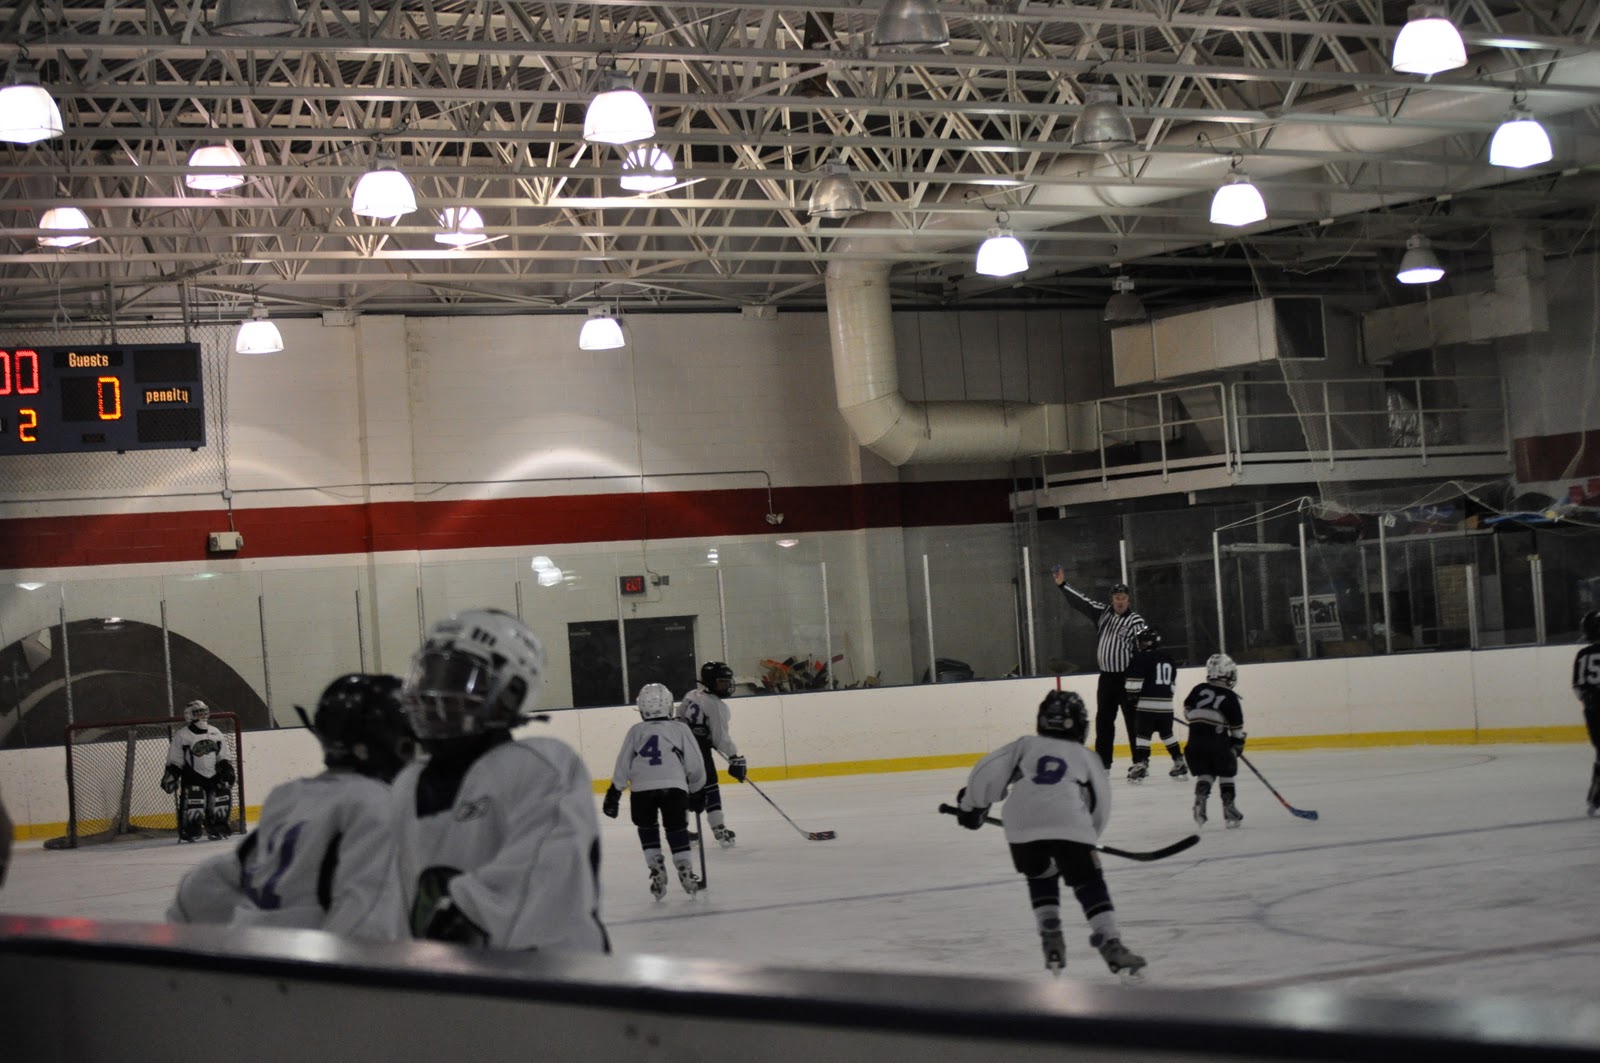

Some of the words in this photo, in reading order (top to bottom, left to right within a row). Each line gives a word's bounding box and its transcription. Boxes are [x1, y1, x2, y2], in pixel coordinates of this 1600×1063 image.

[68, 353, 109, 367] Guests
[97, 376, 122, 420] 0
[145, 387, 189, 404] penalty
[19, 408, 37, 442] 2
[1155, 662, 1172, 685] 10
[1577, 653, 1600, 685] 15
[1196, 688, 1226, 710] 21
[639, 735, 662, 766] 4
[1031, 755, 1068, 785] 9
